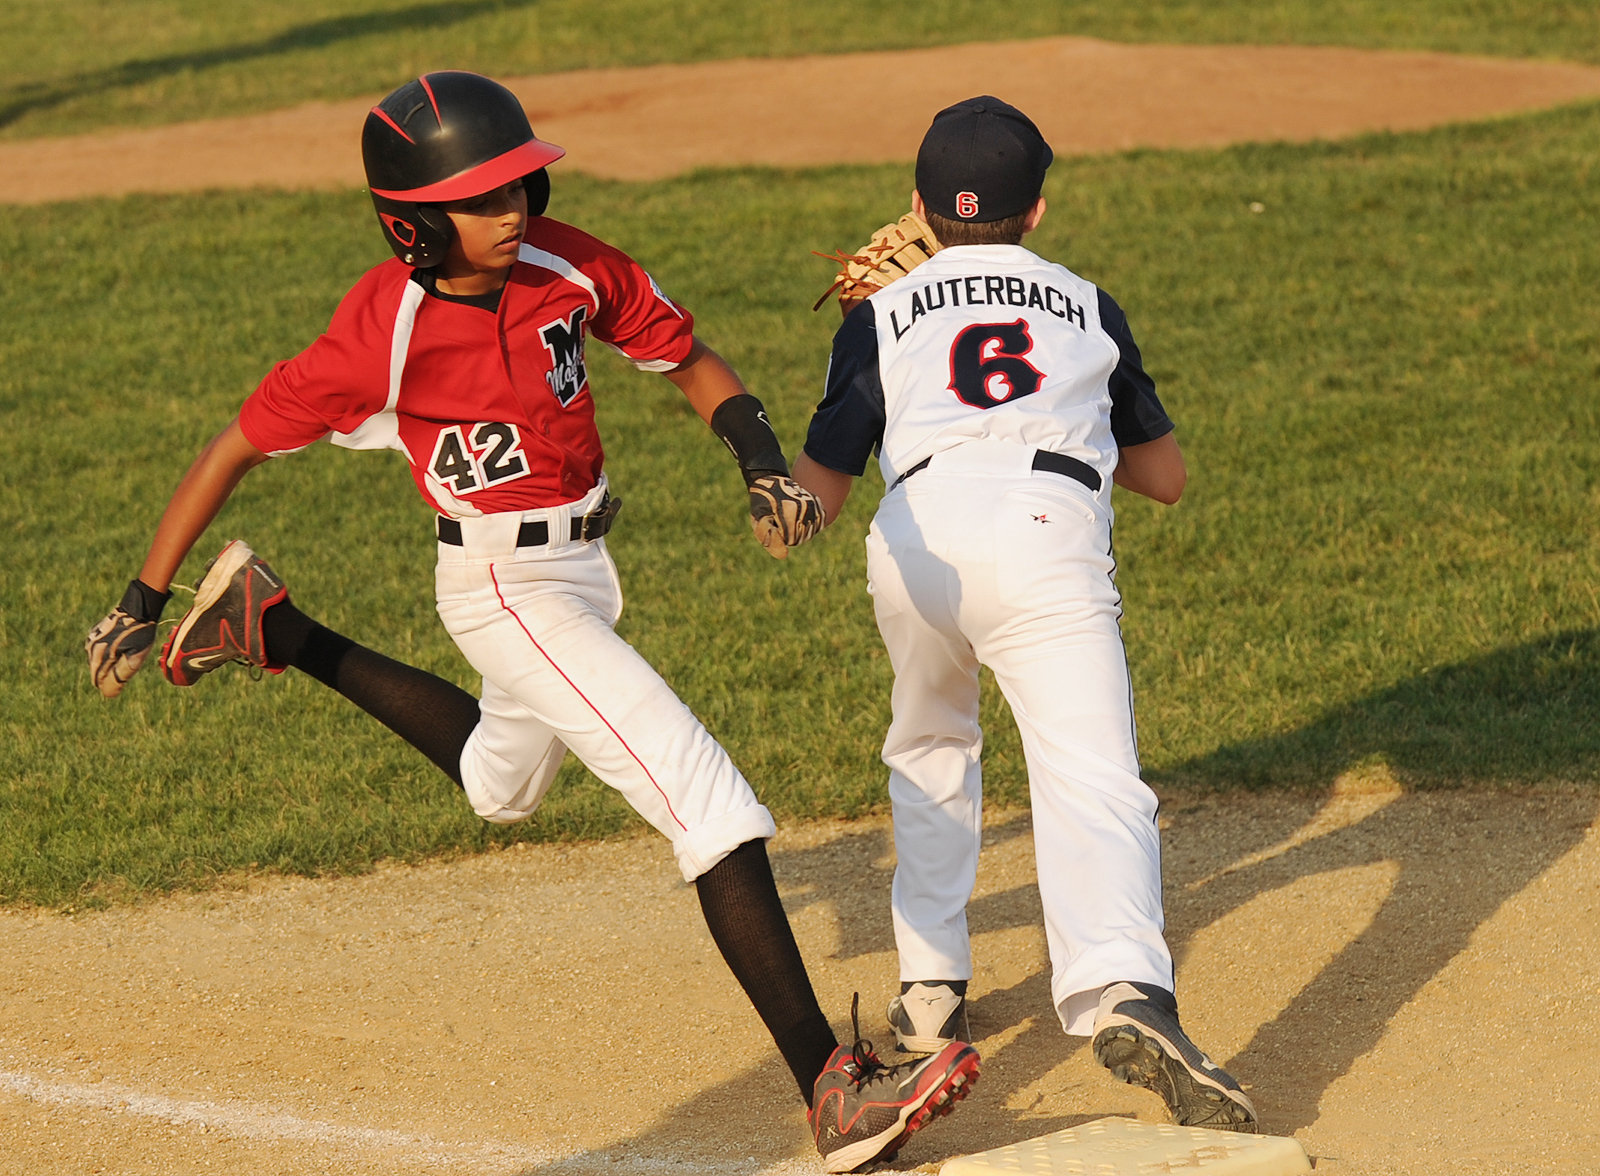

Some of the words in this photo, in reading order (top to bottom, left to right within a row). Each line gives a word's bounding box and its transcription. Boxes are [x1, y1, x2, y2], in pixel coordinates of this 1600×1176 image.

[956, 191, 978, 218] 6
[889, 275, 1087, 344] LAUTERBACH
[537, 304, 588, 408] M
[946, 317, 1048, 410] 6
[427, 421, 531, 496] 42
